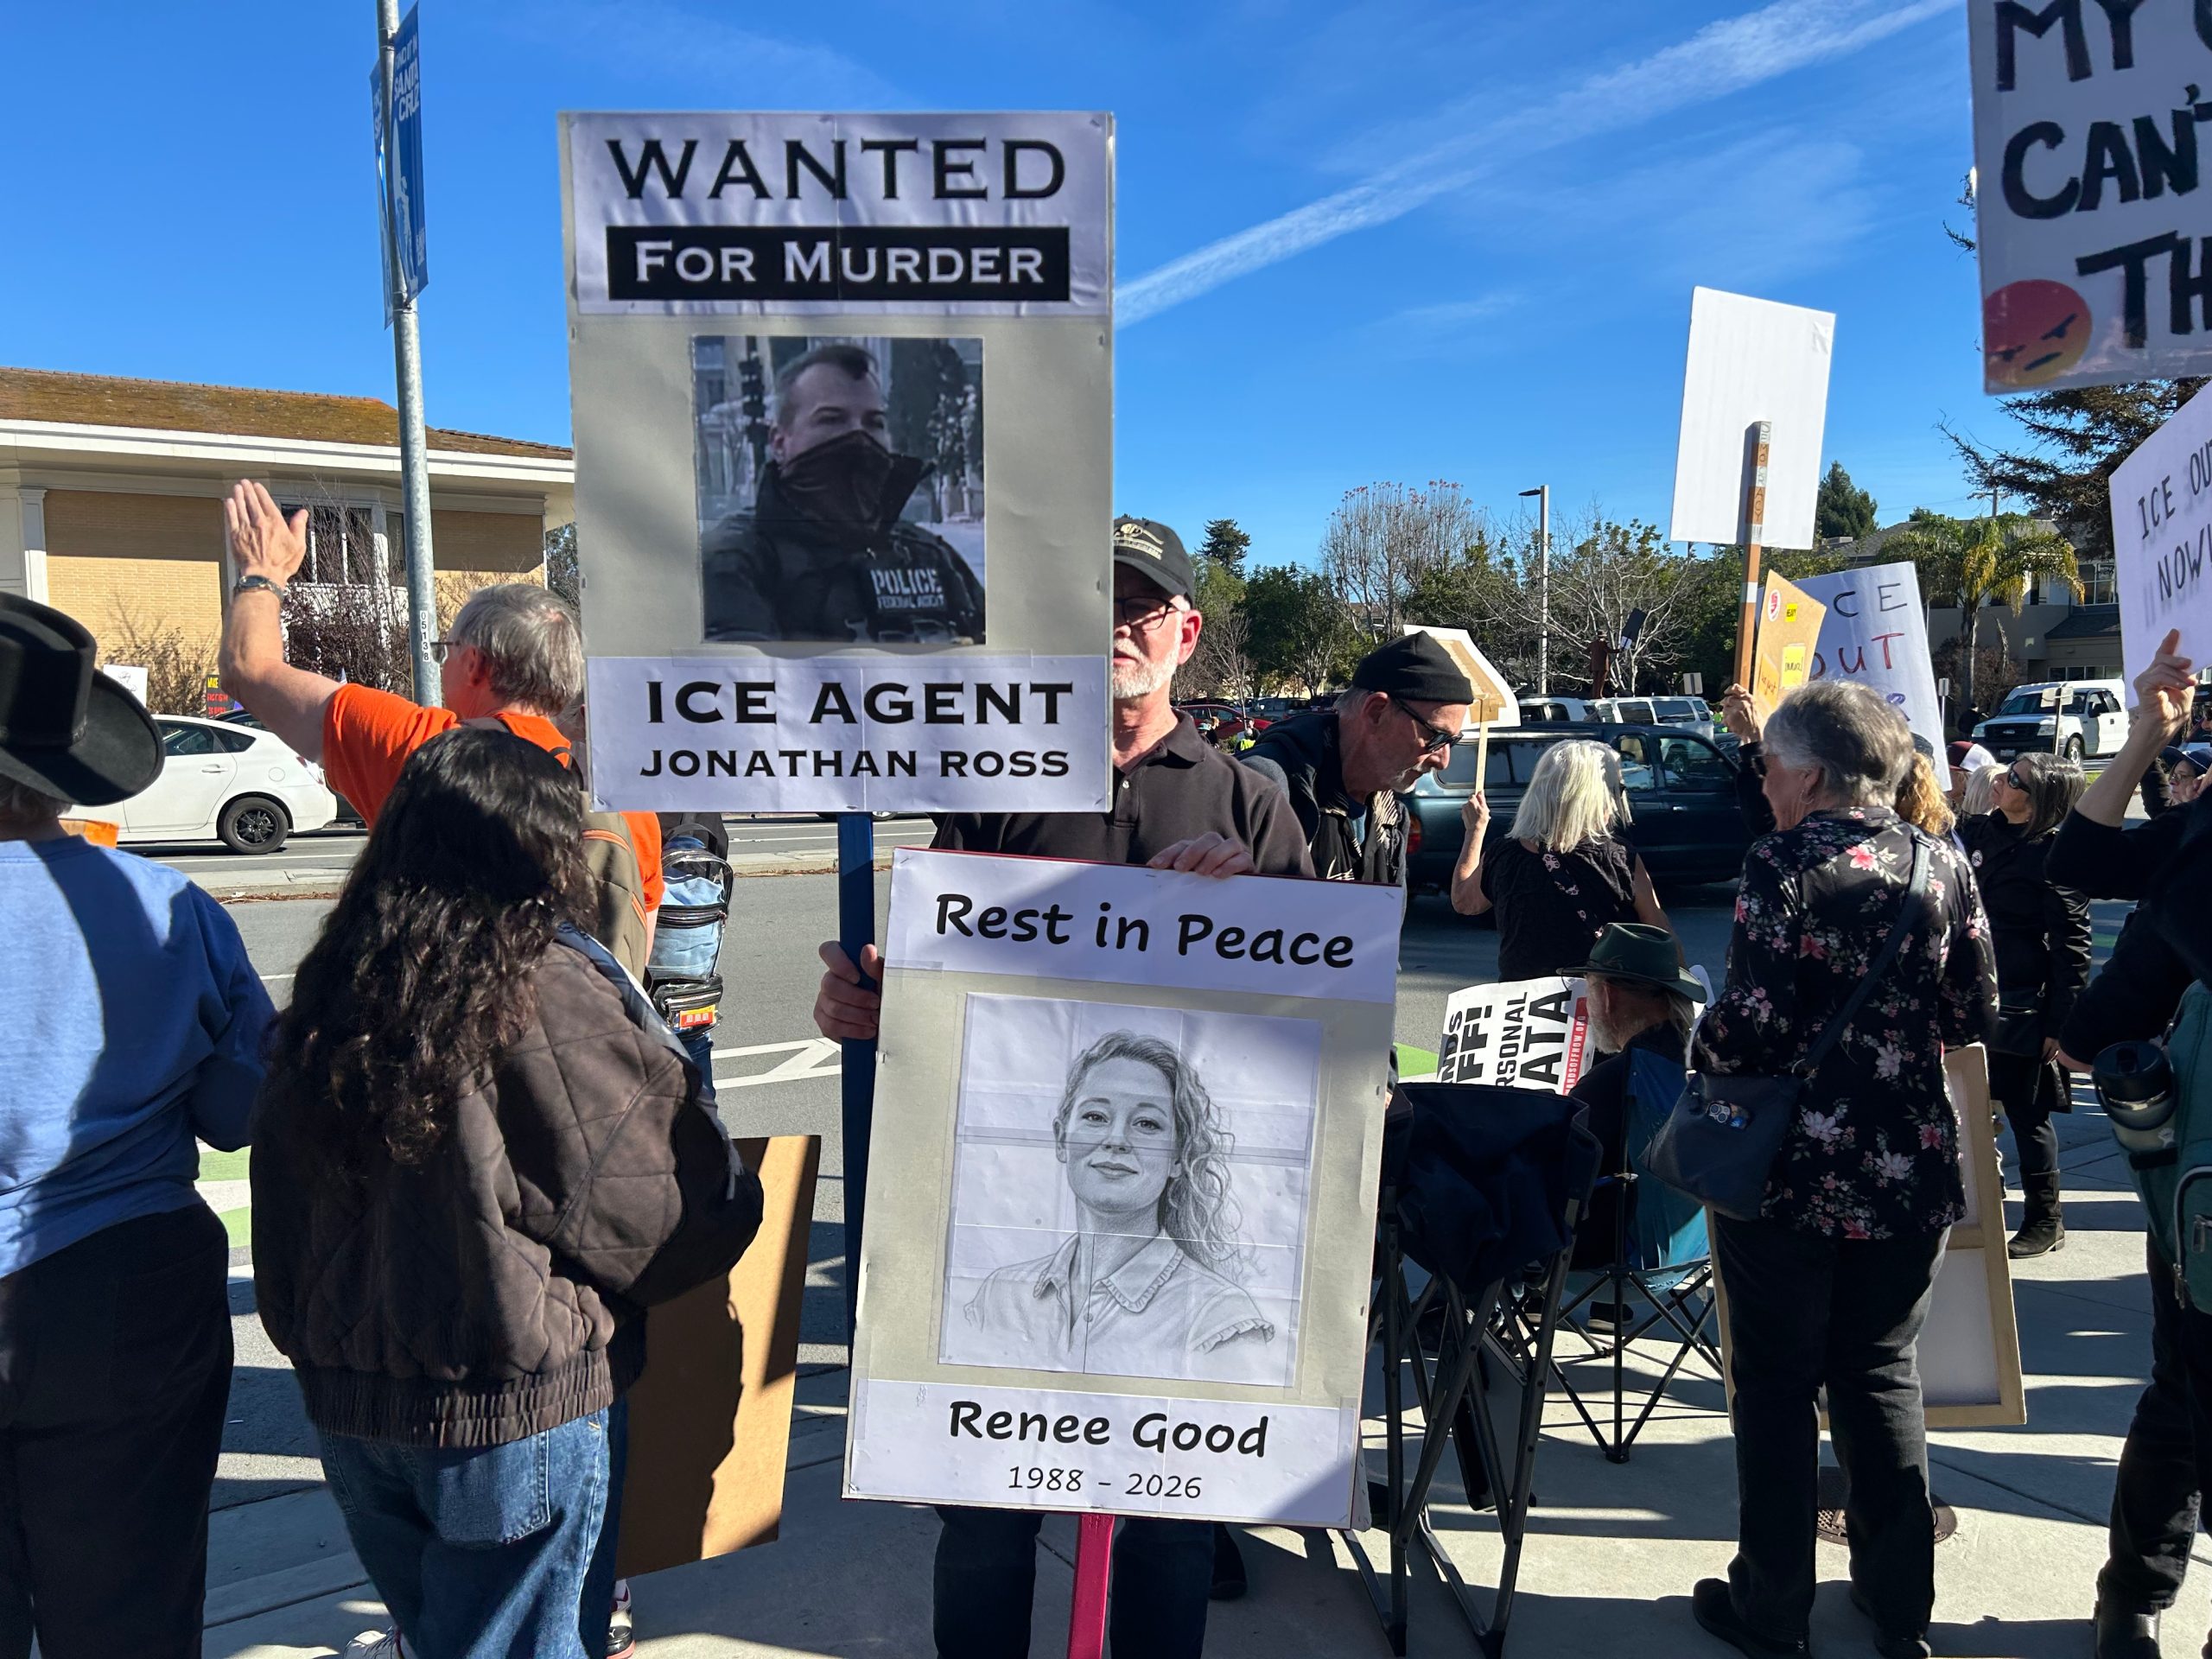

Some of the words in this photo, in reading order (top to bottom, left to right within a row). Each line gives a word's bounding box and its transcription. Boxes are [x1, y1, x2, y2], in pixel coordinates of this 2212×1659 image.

[394, 57, 419, 101] SANTA
[398, 82, 420, 121] CRUZ
[606, 137, 1066, 200] WANTED
[2002, 84, 2212, 219] CAN'
[2138, 475, 2176, 540] ICE
[870, 569, 943, 594] POLICE
[1833, 582, 1908, 618] CE
[421, 612, 429, 662] 05138
[647, 681, 778, 724] ICE
[809, 681, 1074, 725] AGENT
[639, 749, 918, 778] JONATHAN
[940, 750, 1070, 778] ROSS
[936, 893, 1074, 945] Rest
[1095, 902, 1149, 952] in
[1178, 913, 1355, 969] Peace
[1441, 1010, 1463, 1084] NDS
[1456, 1005, 1493, 1084] FF!
[1520, 990, 1573, 1093] ATA
[949, 1401, 1111, 1446] Renee
[1132, 1413, 1269, 1458] Good
[1008, 1466, 1084, 1493] 1988
[1125, 1473, 1203, 1499] 2026
